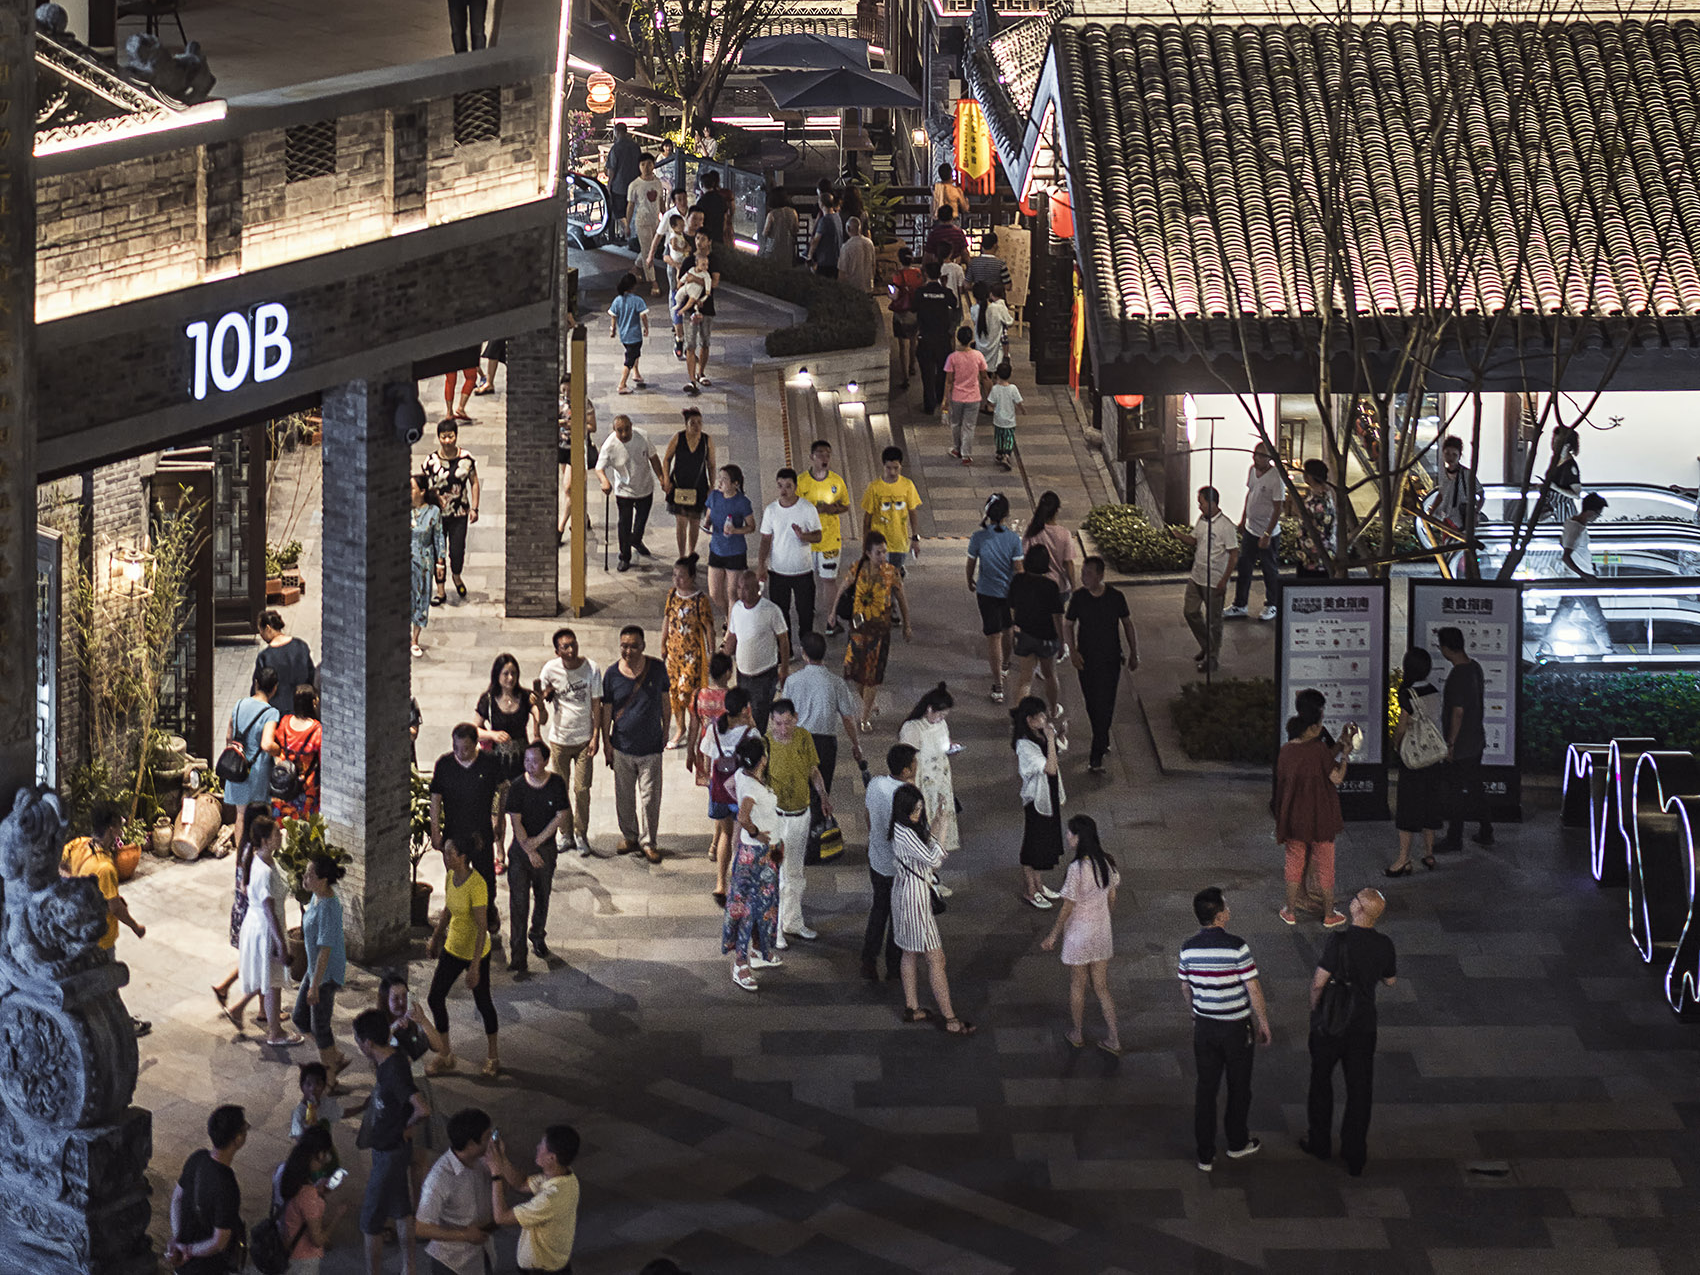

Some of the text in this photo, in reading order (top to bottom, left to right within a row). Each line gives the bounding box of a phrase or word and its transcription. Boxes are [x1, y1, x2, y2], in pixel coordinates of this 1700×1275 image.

[186, 302, 292, 400] 10B
[1323, 597, 1369, 608] 美食指南
[1442, 597, 1493, 610] 美食指南
